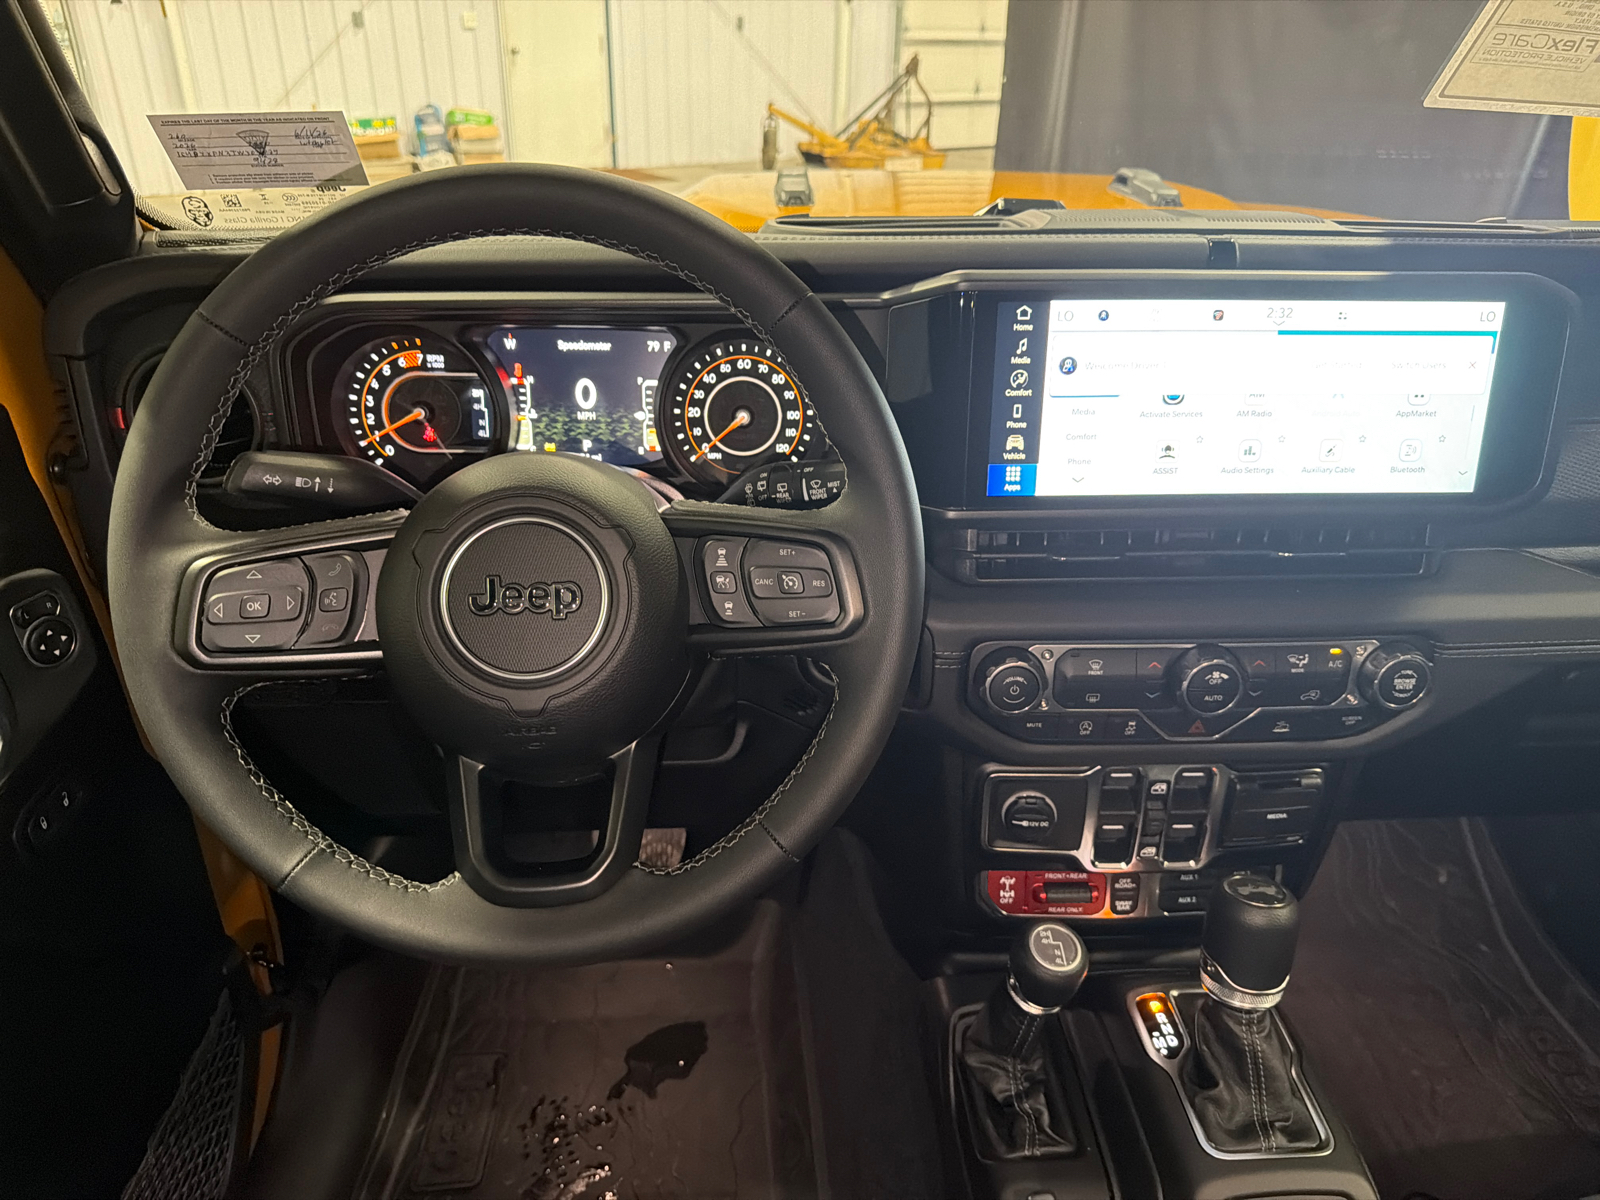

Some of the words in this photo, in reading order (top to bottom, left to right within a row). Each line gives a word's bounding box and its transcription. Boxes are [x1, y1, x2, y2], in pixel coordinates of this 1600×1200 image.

[1057, 311, 1074, 322] LO
[1266, 307, 1294, 319] 2:32
[1480, 311, 1496, 323] LO
[1014, 323, 1033, 332] Home
[504, 338, 516, 350] W
[557, 339, 612, 352] Speedometer
[647, 340, 660, 352] 79
[398, 357, 406, 368] 6
[416, 354, 423, 365] 7
[426, 354, 445, 363] RPM
[1011, 356, 1031, 364] Media
[720, 363, 731, 373] 50
[736, 359, 751, 370] 60
[758, 364, 769, 374] 70
[382, 365, 392, 376] 5
[703, 374, 716, 384] 40
[771, 374, 786, 384] 80
[370, 379, 380, 390] 4
[575, 378, 597, 410] 0
[694, 390, 705, 400] 30
[784, 390, 795, 400] 90
[1005, 388, 1033, 397] Comfort
[366, 395, 375, 407] 3
[577, 412, 596, 421] MPH
[688, 407, 701, 418] 20
[786, 411, 800, 421] 100
[1072, 408, 1096, 416] Media
[1139, 410, 1171, 419] Activate
[1172, 410, 1203, 418] Services
[1236, 410, 1249, 418] AM
[1251, 410, 1273, 418] Radio
[1396, 410, 1437, 419] AppMarket
[366, 413, 376, 425] 2
[1006, 420, 1027, 429] Phone
[693, 427, 702, 436] 10
[786, 428, 797, 437] 110
[1066, 432, 1097, 441] Comfort
[582, 439, 592, 452] P
[776, 444, 790, 453] 120
[385, 445, 395, 457] 0
[707, 452, 722, 460] MPH
[1003, 452, 1026, 461] Vehicle
[1067, 458, 1092, 466] Phone
[1152, 467, 1179, 475] ASSIST
[1221, 466, 1241, 474] Audio
[1243, 467, 1274, 476] Settings
[1301, 466, 1335, 475] Auxiliary
[1336, 466, 1356, 474] Cable
[1390, 466, 1426, 474] Bluetooth
[809, 488, 826, 496] FRONT
[1004, 484, 1021, 492] Apps
[754, 578, 774, 586] CANC
[468, 575, 583, 620] Jeep
[246, 601, 262, 611] OK
[1328, 660, 1343, 668] A/C
[1394, 678, 1417, 686] BROWSE
[1155, 1012, 1168, 1024] R
[1160, 1023, 1174, 1035] N
[1152, 1036, 1168, 1049] M
[1166, 1035, 1179, 1048] D
